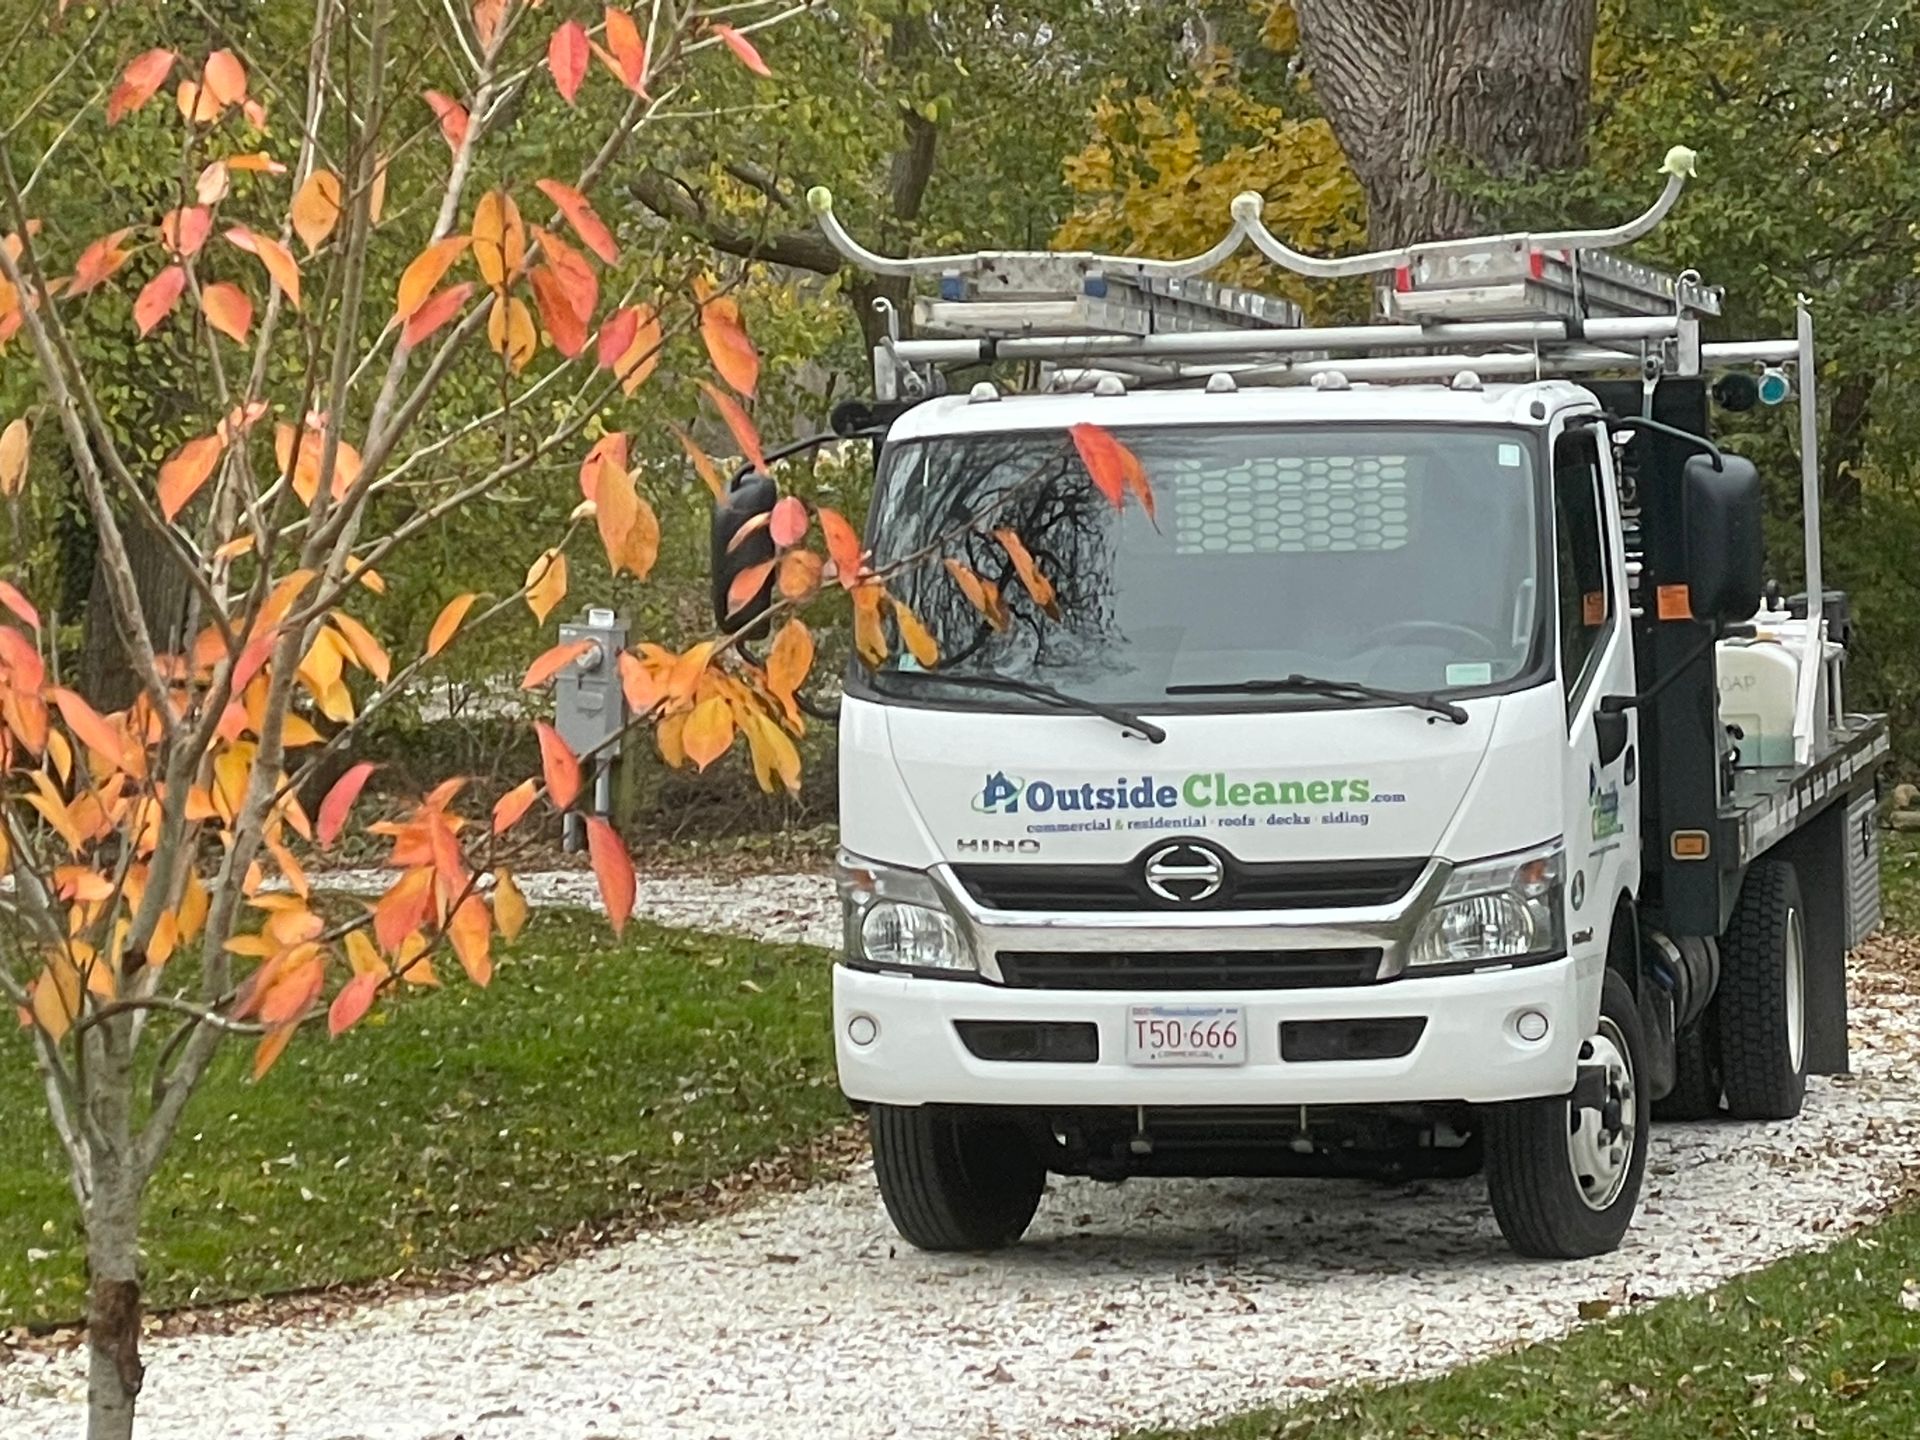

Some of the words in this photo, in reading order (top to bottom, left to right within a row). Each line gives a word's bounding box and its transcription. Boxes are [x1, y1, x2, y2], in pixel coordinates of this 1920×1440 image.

[1026, 818, 1111, 833] commercial
[1127, 815, 1207, 830] residential
[1218, 814, 1255, 827] roofs
[1266, 812, 1311, 826] decks
[1321, 811, 1370, 826] siding
[957, 839, 1040, 854] HINO
